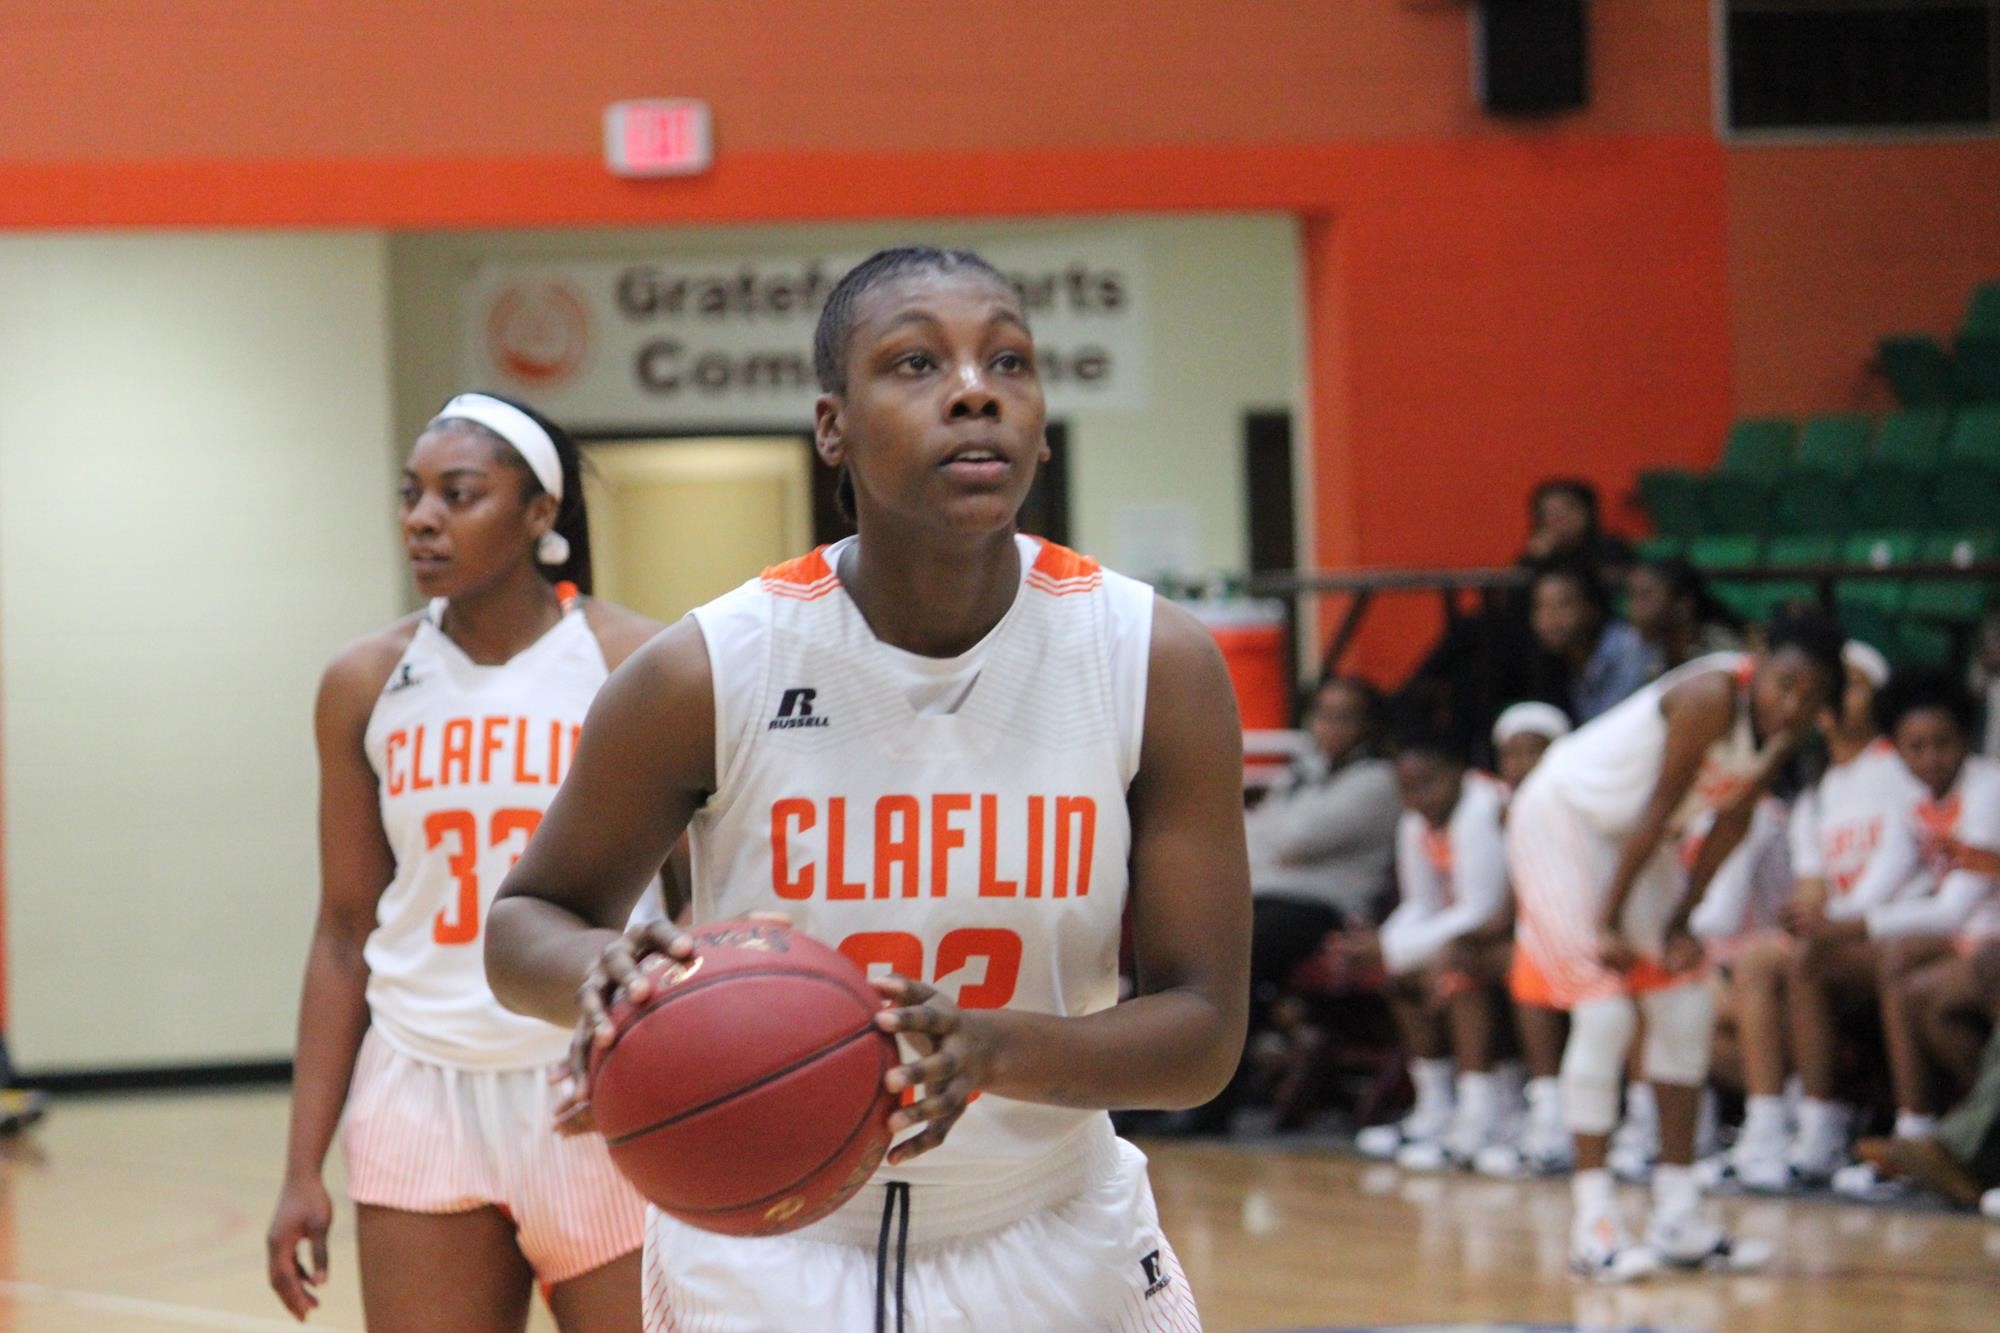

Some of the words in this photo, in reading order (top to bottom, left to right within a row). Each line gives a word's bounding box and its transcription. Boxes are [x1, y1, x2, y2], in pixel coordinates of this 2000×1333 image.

[616, 264, 828, 322] Gratef
[636, 337, 814, 396] Com
[768, 716, 829, 731] RUSSELL
[387, 715, 582, 797] CLAFLI
[771, 793, 1096, 901] CLAFLIN
